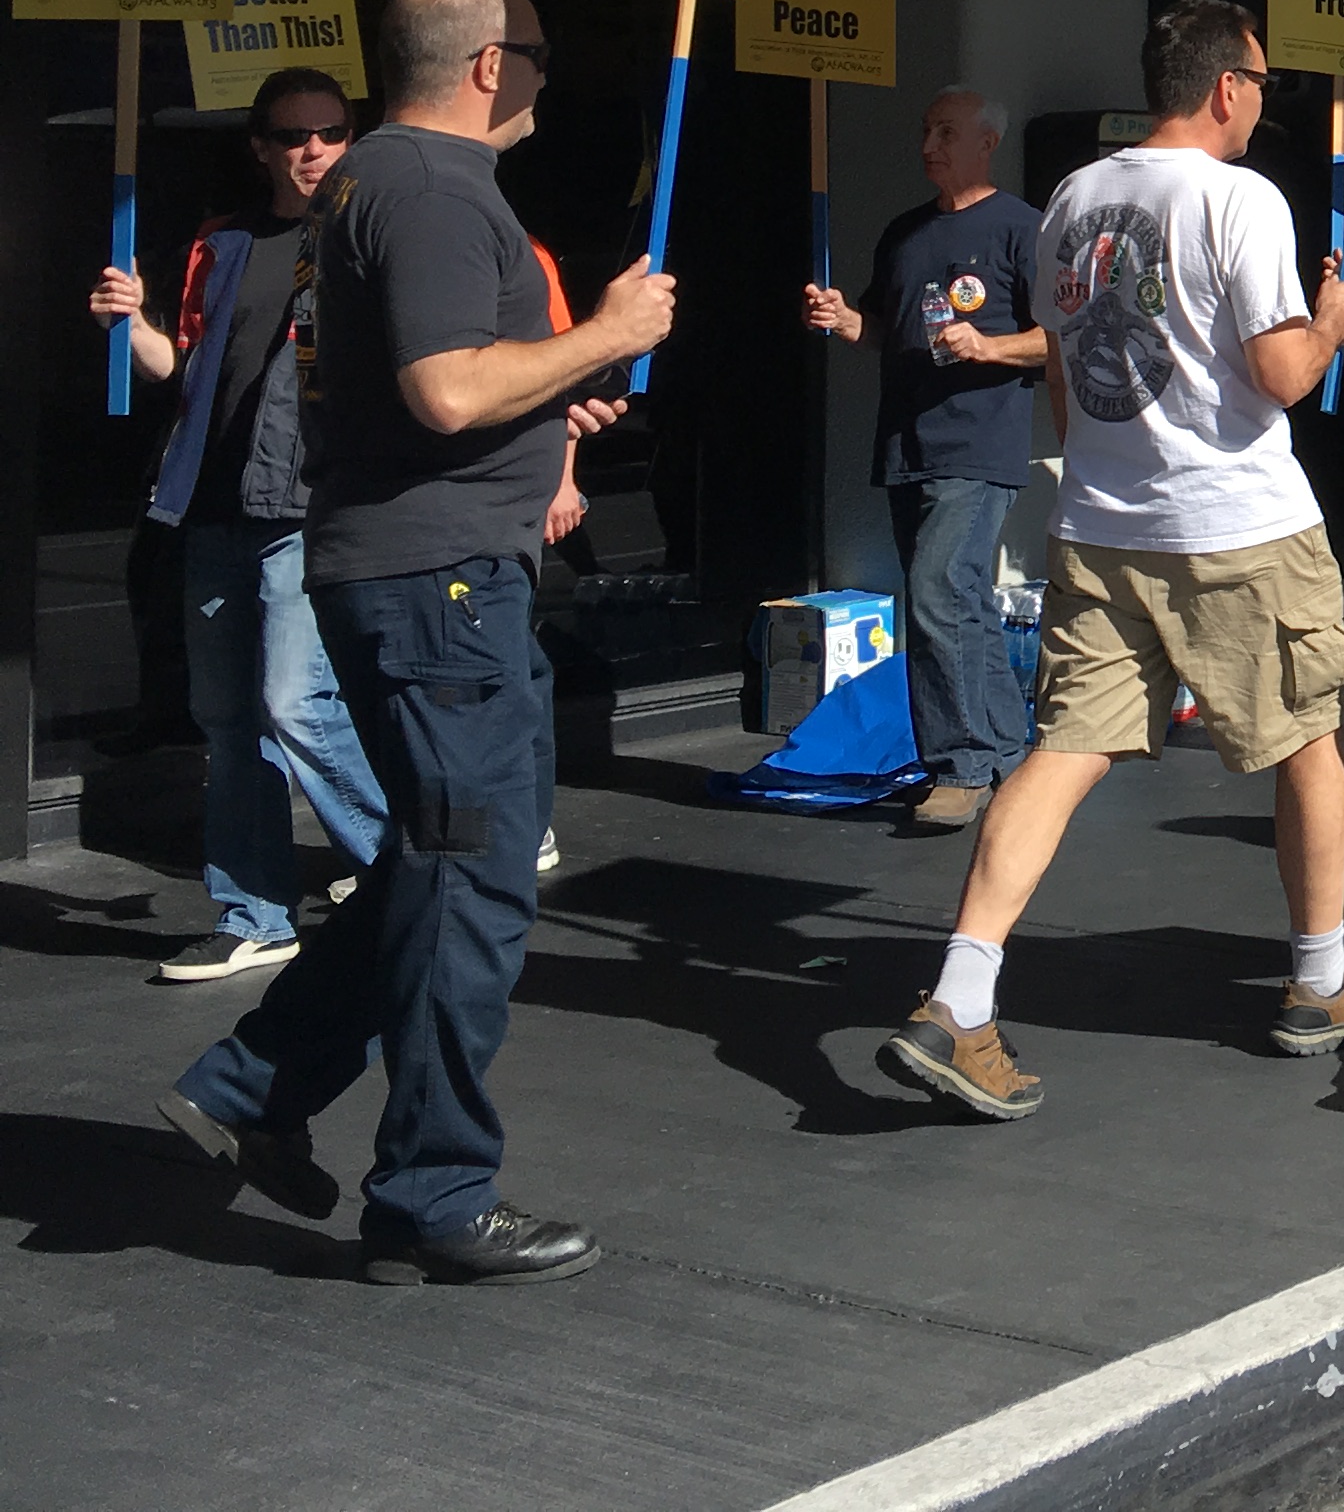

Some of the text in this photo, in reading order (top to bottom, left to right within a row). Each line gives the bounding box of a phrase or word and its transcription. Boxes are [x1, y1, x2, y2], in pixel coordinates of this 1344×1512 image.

[204, 14, 344, 53] Than This!
[773, 0, 859, 40] Peace
